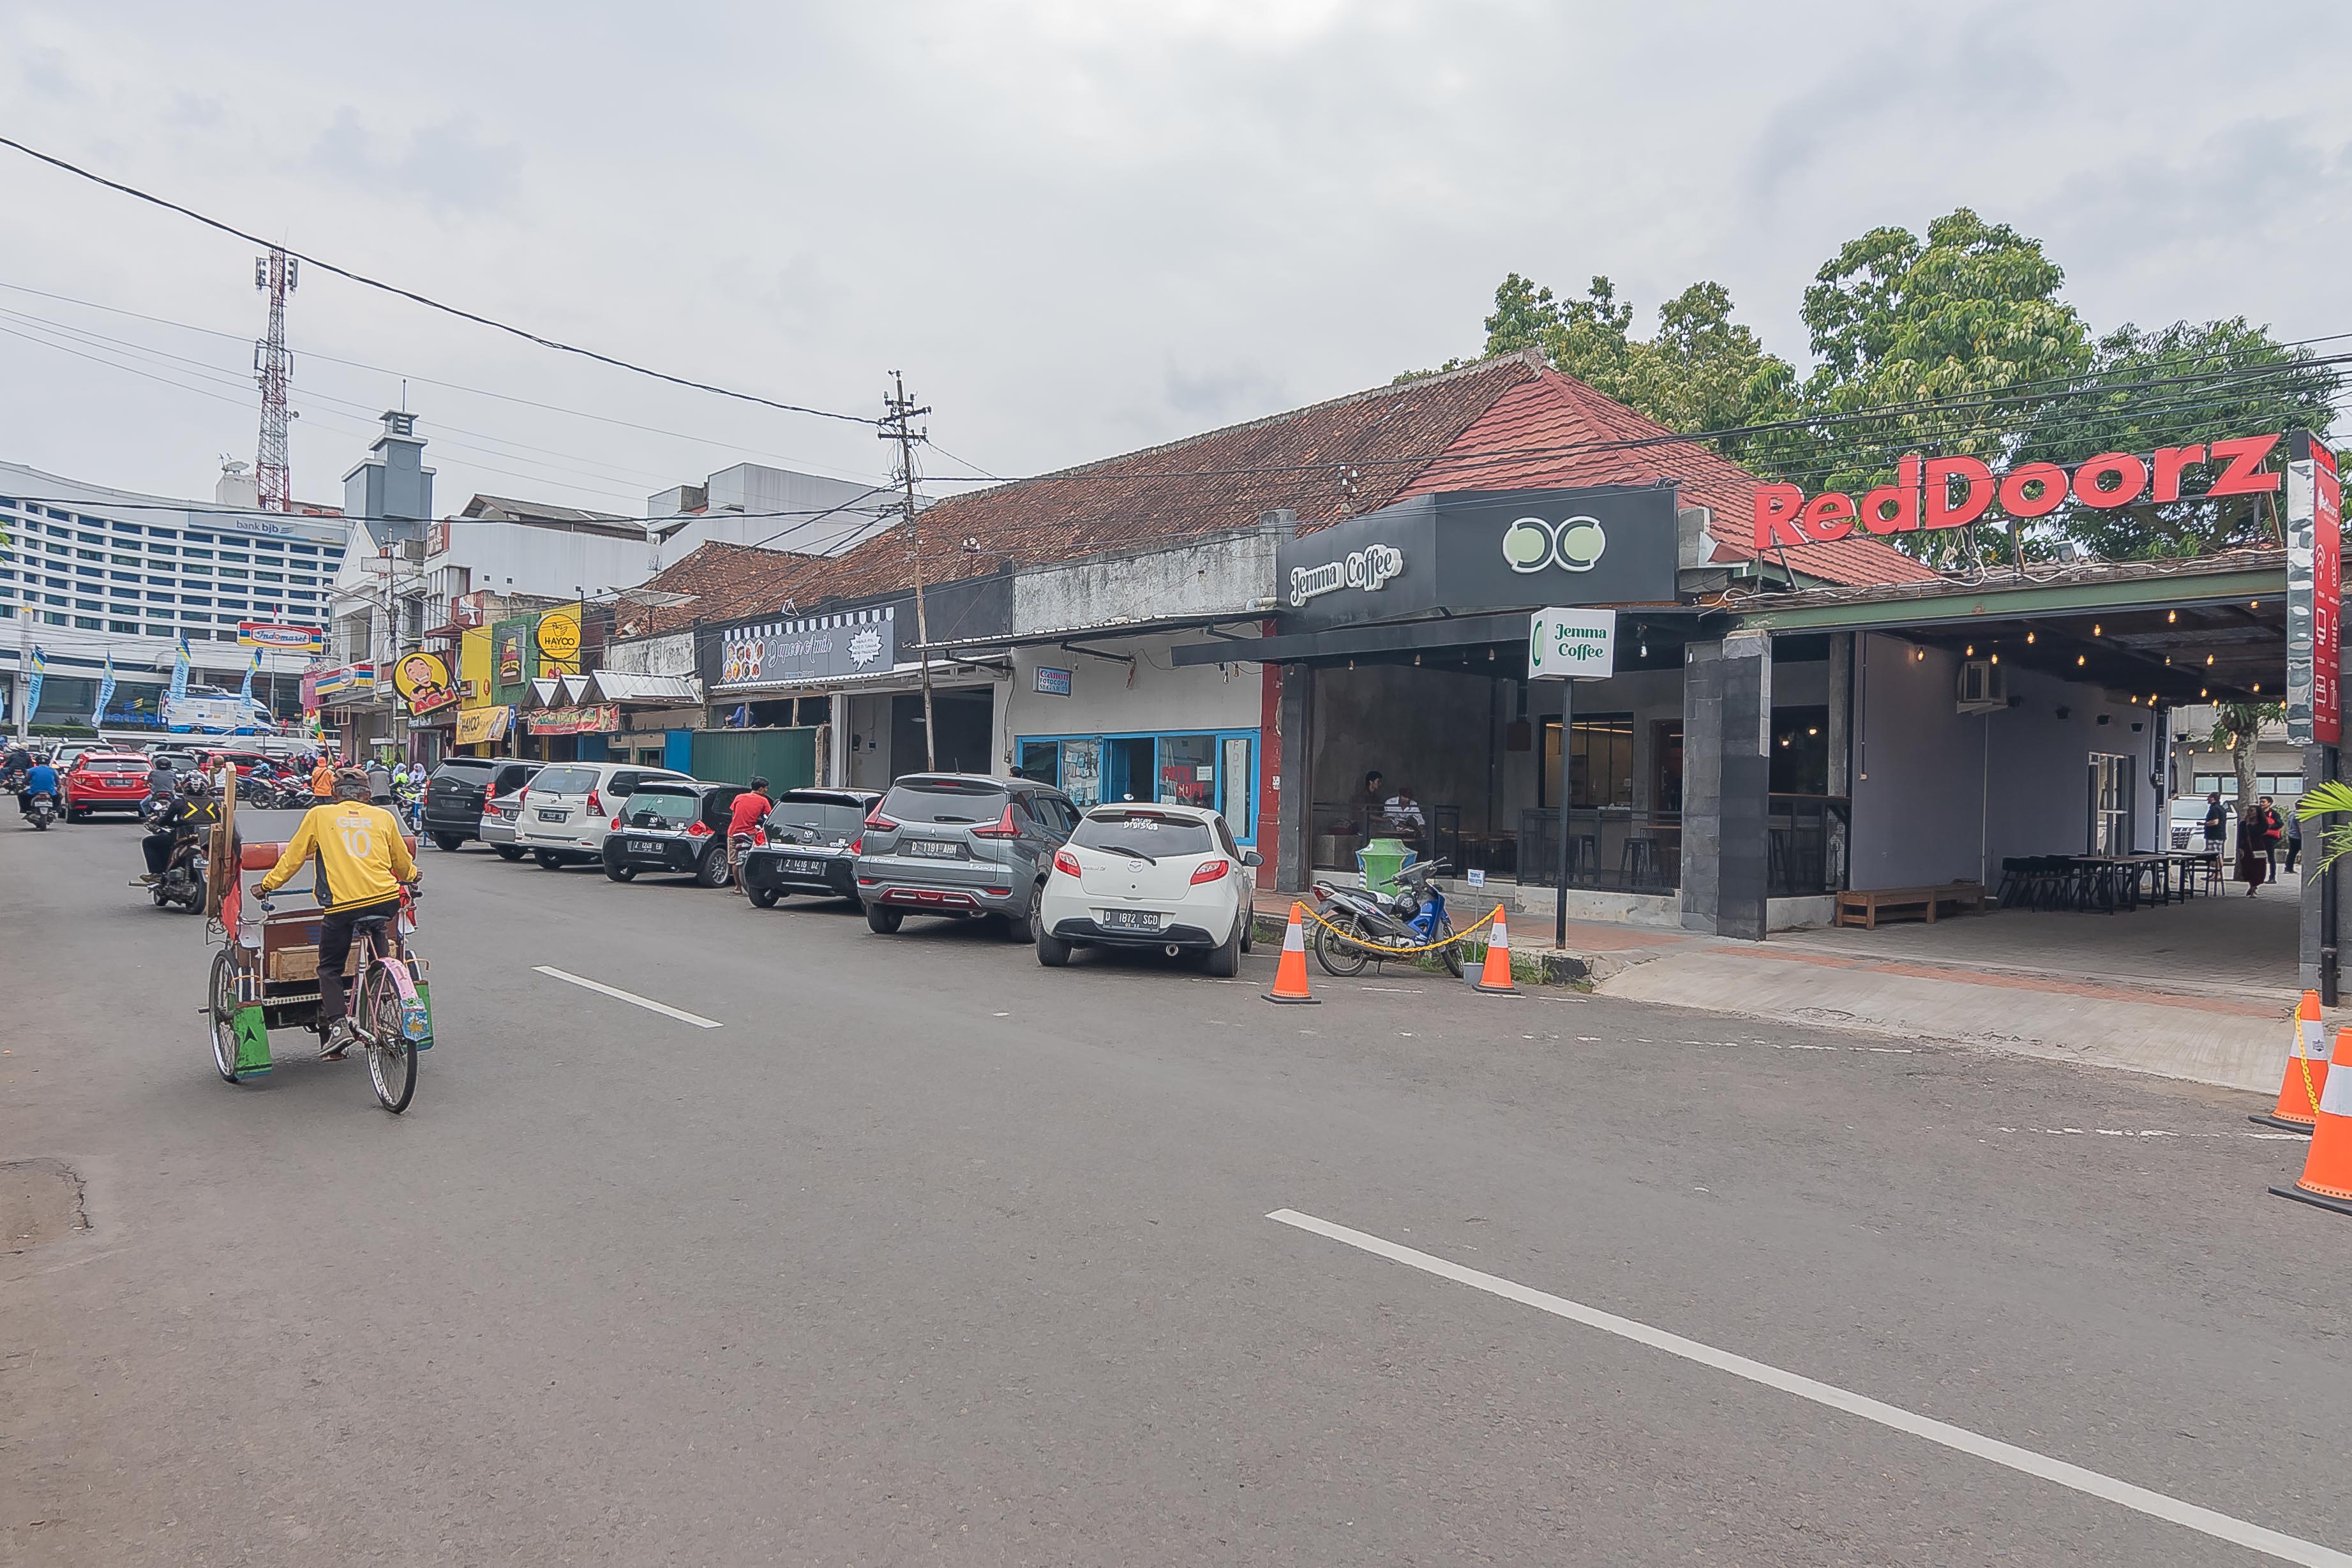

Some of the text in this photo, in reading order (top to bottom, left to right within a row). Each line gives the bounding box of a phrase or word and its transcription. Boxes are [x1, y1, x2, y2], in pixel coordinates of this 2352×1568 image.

[1754, 433, 2282, 550] RedDoorz
[236, 519, 279, 534] bank bjb
[1291, 546, 1397, 604] Jemma Coffee
[255, 630, 307, 642] Indomaret
[1554, 623, 1607, 640] Jemma
[544, 637, 575, 646] HAYOO
[1558, 643, 1605, 661] Coffee
[1040, 669, 1068, 681] Canon
[1040, 678, 1068, 686] FOTOCOPY
[510, 708, 515, 726] P
[1162, 766, 1190, 782] FOTO
[337, 816, 373, 829] GER
[342, 830, 371, 858] 10
[912, 841, 957, 854] D 1191 AHM
[1105, 911, 1158, 925] D 1872 SGD
